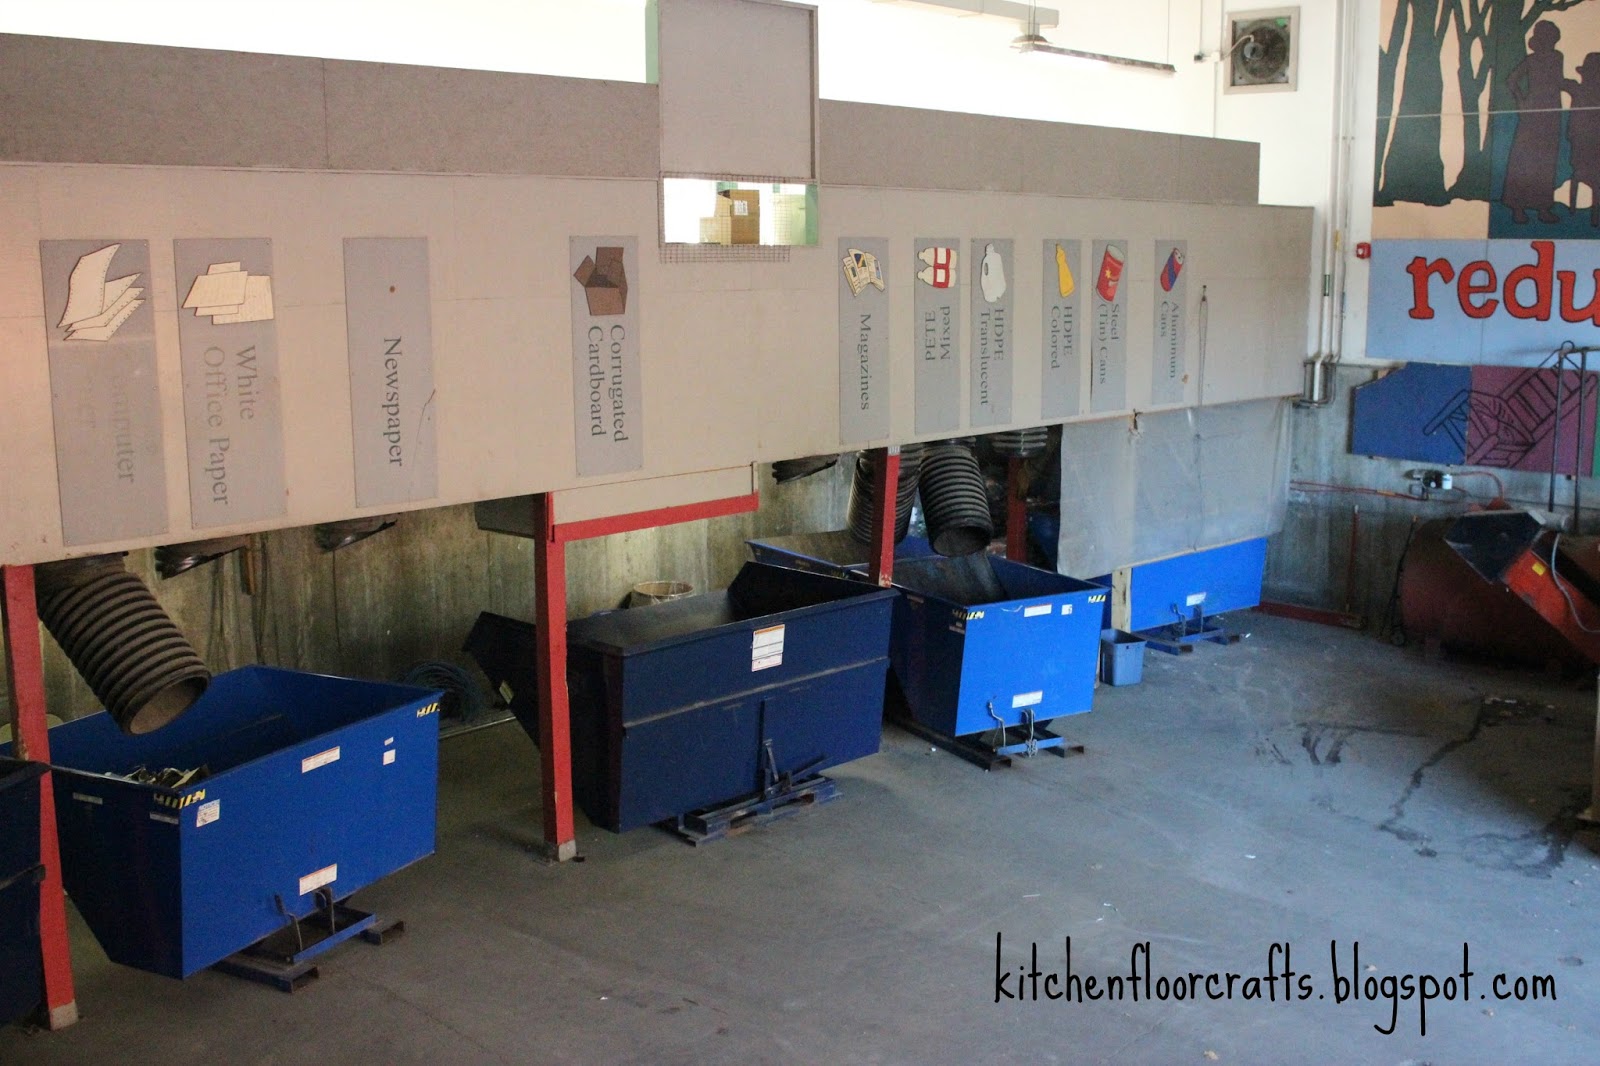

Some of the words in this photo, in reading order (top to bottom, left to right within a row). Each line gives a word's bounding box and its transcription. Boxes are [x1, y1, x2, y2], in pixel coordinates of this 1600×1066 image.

[1160, 301, 1169, 338] Cans
[1406, 241, 1600, 327] redu
[925, 310, 936, 361] PETE
[940, 306, 951, 361] Mixed
[980, 310, 990, 406] Translucent
[994, 308, 1004, 362] HDPE
[1051, 306, 1060, 370] Colored
[1063, 306, 1073, 357] HDPE
[1111, 303, 1120, 341] Steel
[1169, 302, 1179, 379] Aluminum
[203, 346, 229, 428] Office
[235, 345, 259, 421] White
[588, 326, 606, 437] Cardboard
[608, 324, 629, 443] Corrugated
[857, 313, 871, 411] Magazines
[1099, 346, 1108, 385] Cans
[383, 336, 402, 467] Newspaper
[205, 436, 230, 505] Paper
